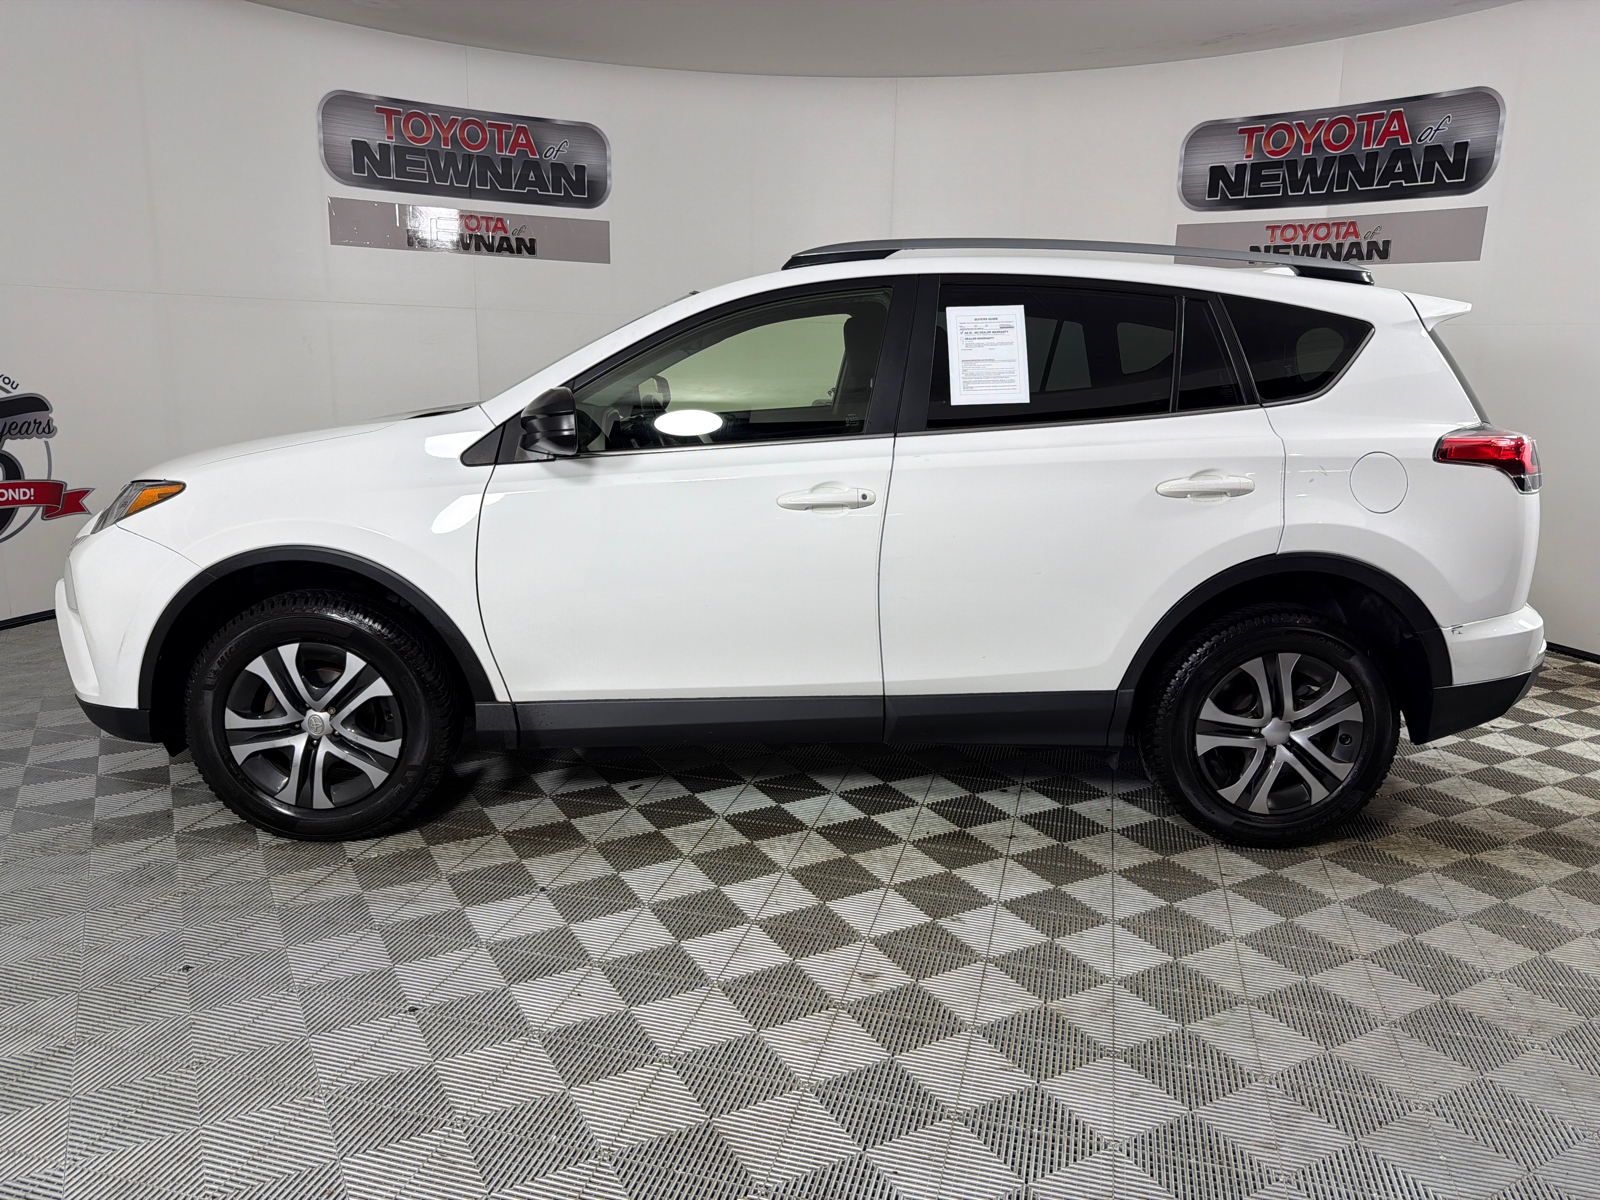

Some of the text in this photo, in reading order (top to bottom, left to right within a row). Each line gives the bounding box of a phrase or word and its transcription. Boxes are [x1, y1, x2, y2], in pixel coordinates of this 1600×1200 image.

[375, 105, 569, 160] TOYOTA of
[1238, 108, 1451, 160] TOYOTA of
[351, 139, 588, 198] NEWNAN
[1205, 139, 1471, 200] NEWNAN
[1265, 220, 1382, 243] TOYOTA of
